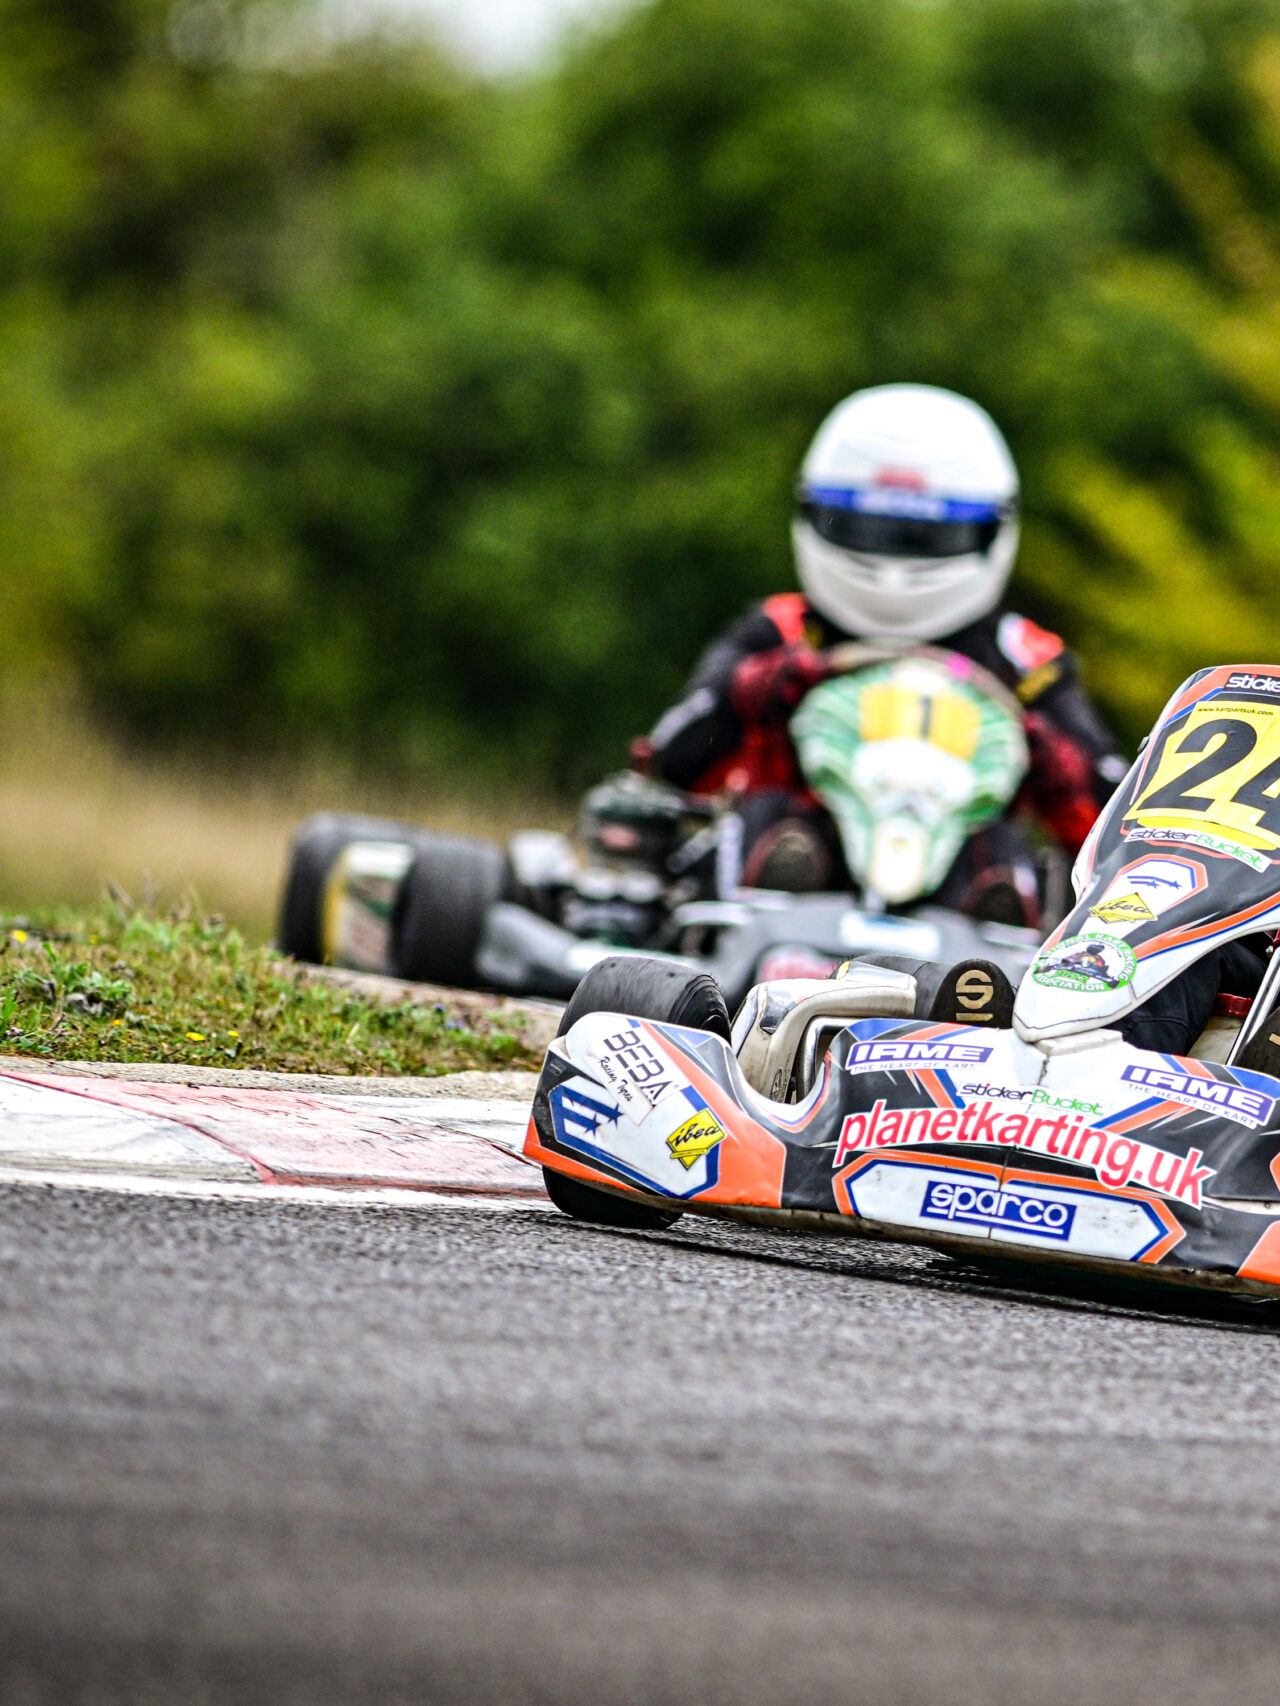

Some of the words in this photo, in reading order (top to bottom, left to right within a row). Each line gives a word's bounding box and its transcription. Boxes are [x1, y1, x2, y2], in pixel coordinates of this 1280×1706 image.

[1197, 706, 1274, 717] www.kartpartsuk.com
[1130, 827, 1263, 870] stickerBucket
[855, 1043, 985, 1062] IAME
[600, 1055, 618, 1084] Racing
[617, 1079, 633, 1102] Tyres
[960, 1083, 1104, 1117] stickerBucket
[1129, 1067, 1264, 1116] IAME
[1128, 1083, 1151, 1094] THE
[1157, 1090, 1199, 1106] HEART
[1202, 1104, 1218, 1112] OF
[1224, 1110, 1255, 1127] KART
[670, 1122, 722, 1147] ibea
[835, 1100, 1213, 1203] planetkarting.uk
[929, 1184, 1069, 1228] sparco
